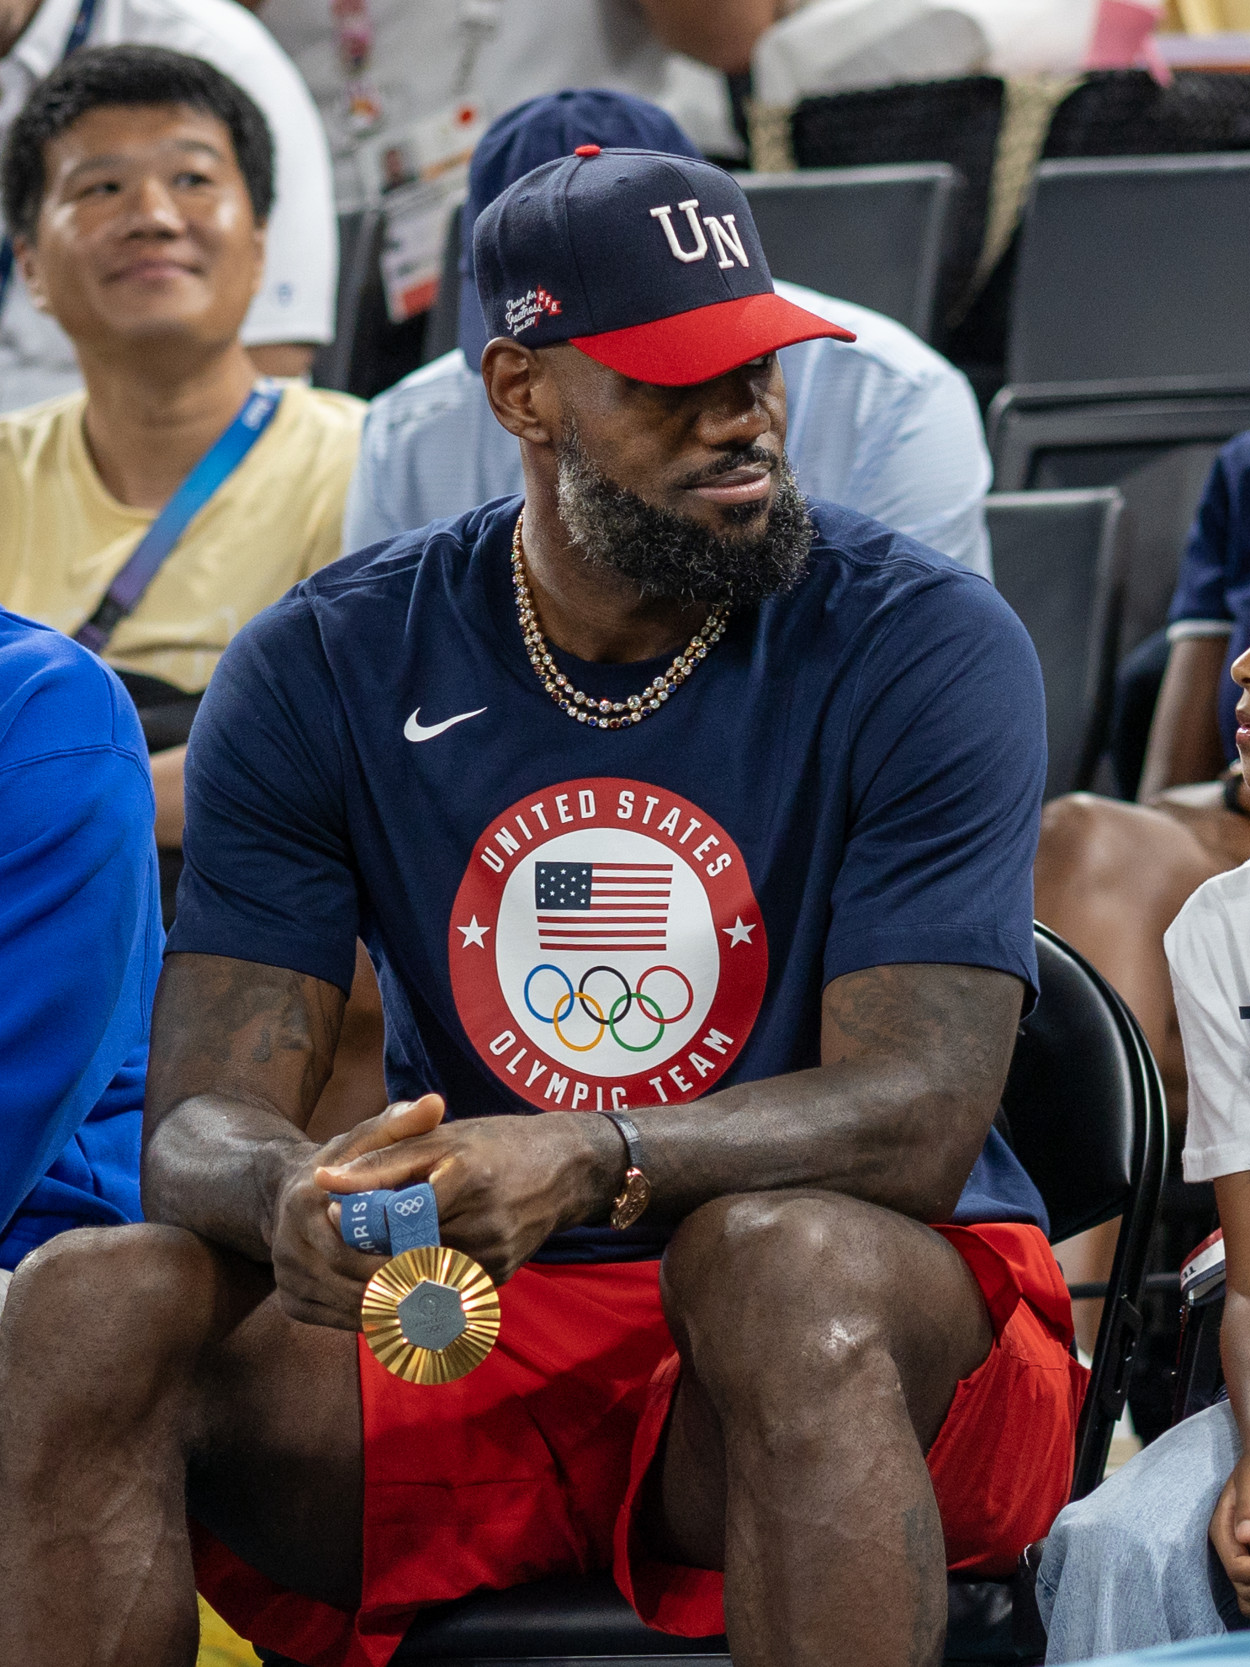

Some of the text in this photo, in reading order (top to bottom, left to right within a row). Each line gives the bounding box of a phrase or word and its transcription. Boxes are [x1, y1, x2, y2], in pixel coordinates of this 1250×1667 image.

[650, 199, 749, 269] UN
[480, 789, 733, 877] UNITED STATES
[489, 1028, 734, 1111] OLYMPIC TEAM
